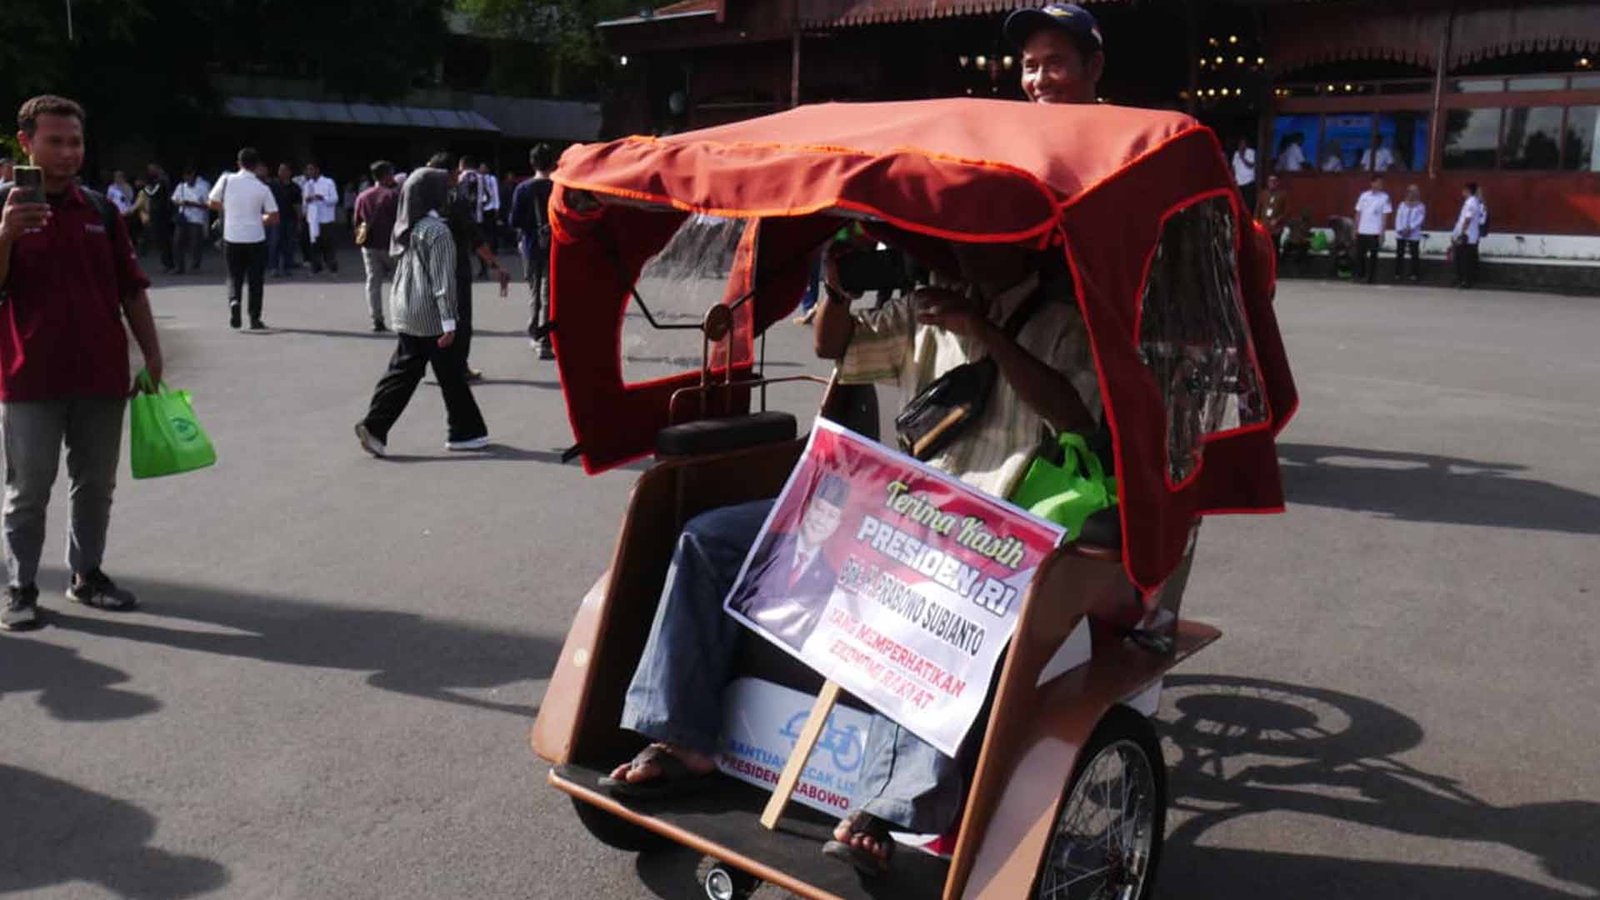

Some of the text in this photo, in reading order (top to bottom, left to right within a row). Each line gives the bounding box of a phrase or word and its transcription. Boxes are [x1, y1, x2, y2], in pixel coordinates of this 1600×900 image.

[886, 480, 1026, 570] Terima Kasih
[857, 515, 1017, 618] PRESIDEN RI
[877, 573, 927, 623] PRABOWO
[921, 601, 986, 657] SUBIANTO
[855, 624, 967, 698] MEMPERHATIKAN
[879, 670, 935, 709] RAKYAT
[794, 781, 850, 810] RABOWO
